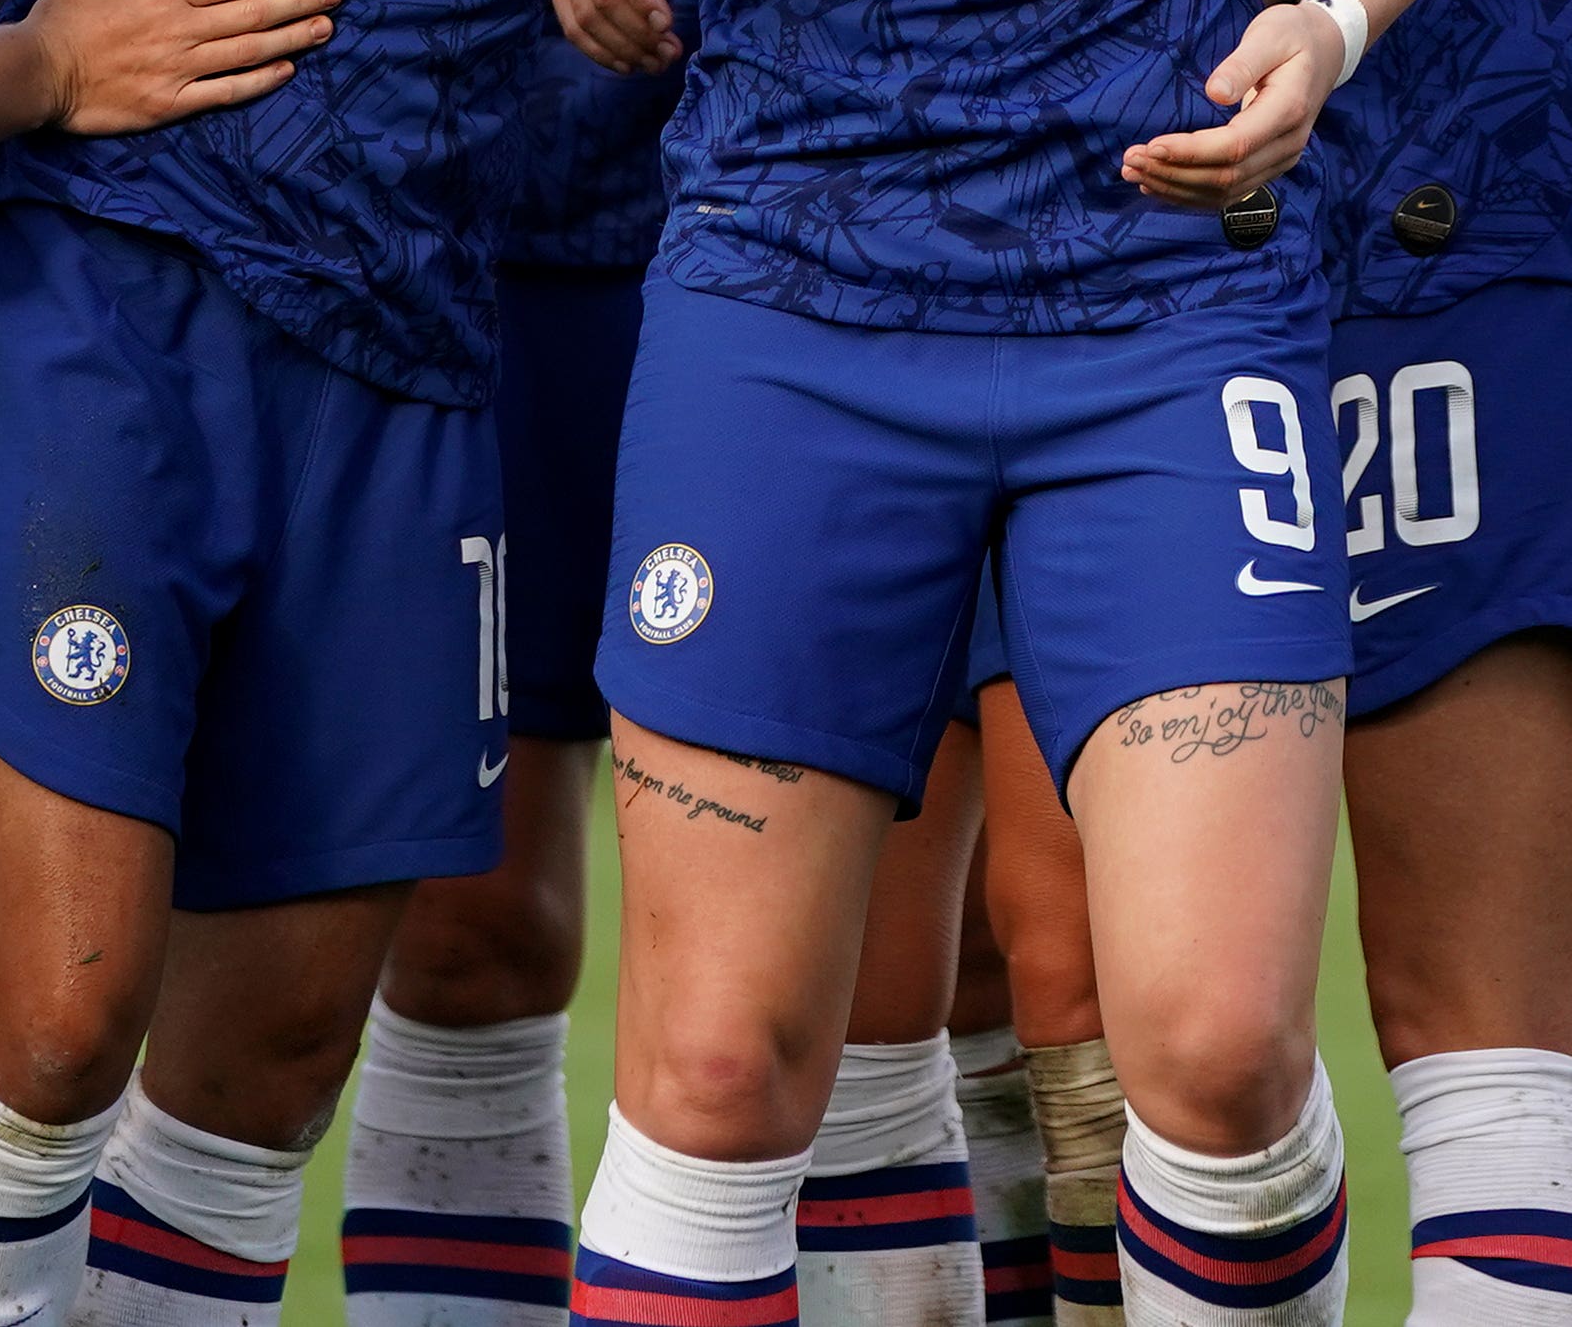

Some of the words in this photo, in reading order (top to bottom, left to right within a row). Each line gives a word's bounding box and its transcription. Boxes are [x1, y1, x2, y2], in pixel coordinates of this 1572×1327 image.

[1221, 376, 1315, 552] 9
[1331, 360, 1480, 557] 20
[646, 547, 699, 571] CHELSEA
[54, 608, 117, 635] CHELSEA
[674, 618, 694, 635] CLUB
[47, 677, 88, 700] FOOTBALL
[1162, 697, 1268, 764] enjoy
[644, 775, 663, 794] on
[667, 782, 693, 806] the
[687, 797, 768, 833] ground
